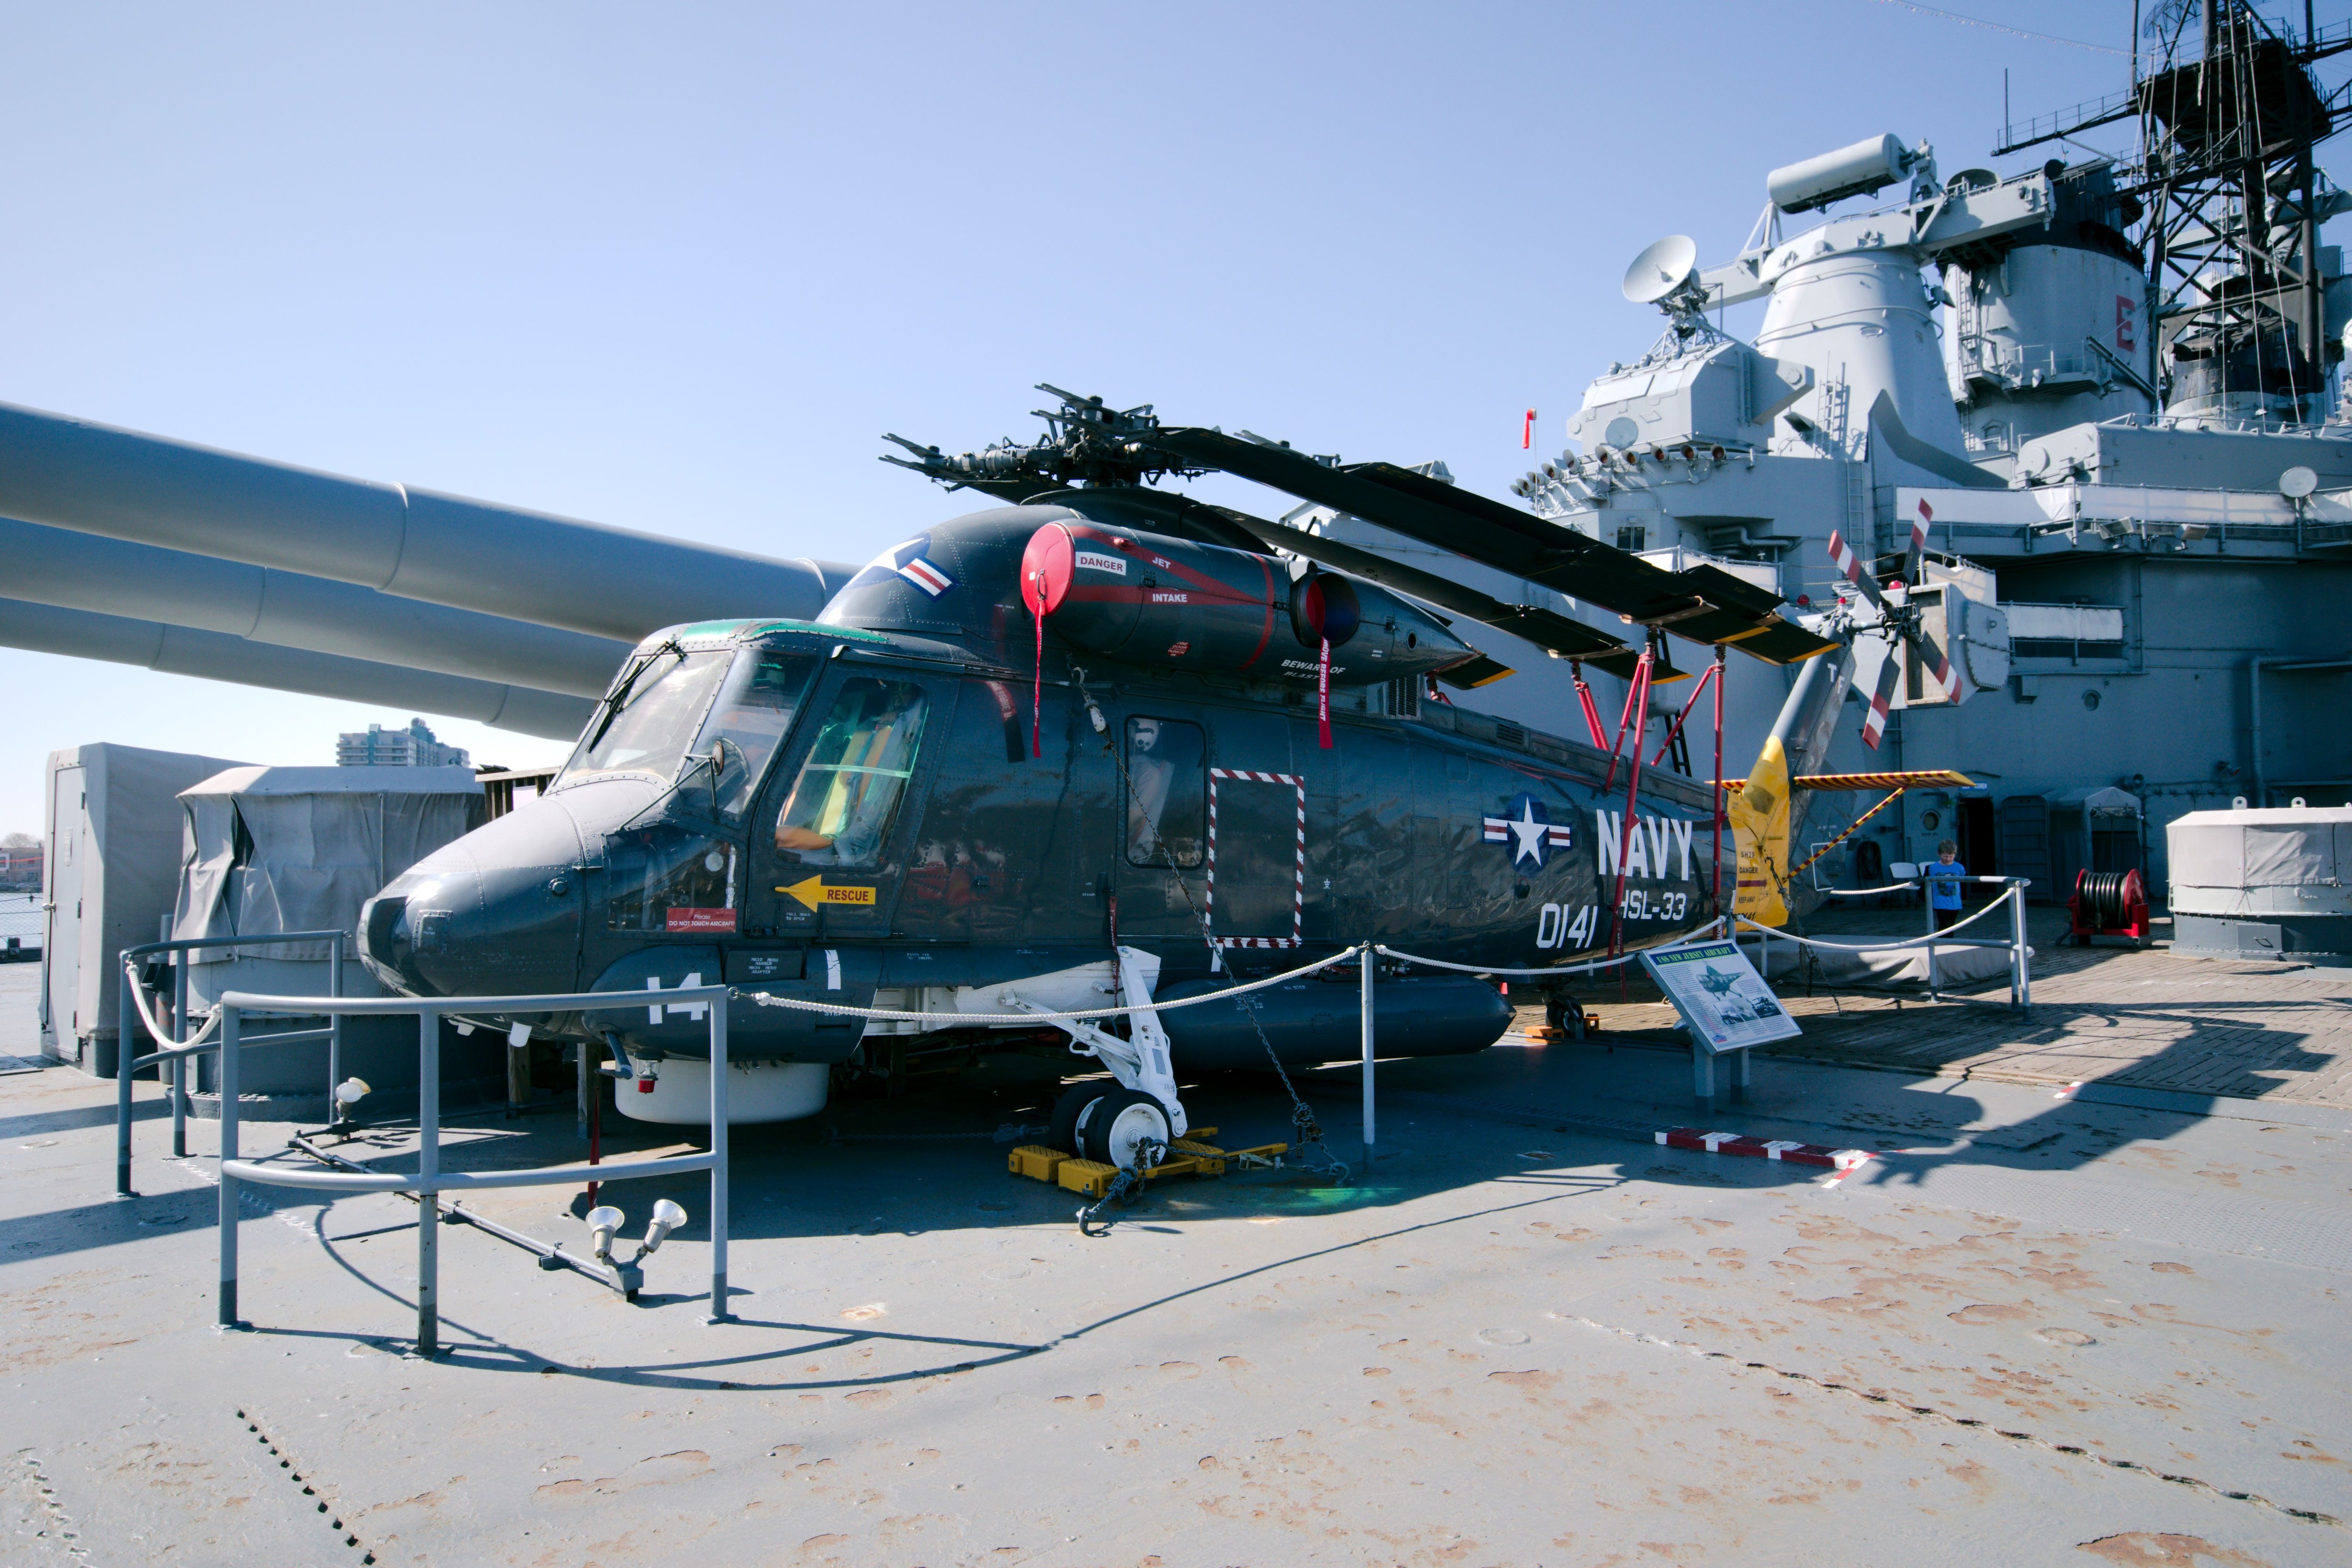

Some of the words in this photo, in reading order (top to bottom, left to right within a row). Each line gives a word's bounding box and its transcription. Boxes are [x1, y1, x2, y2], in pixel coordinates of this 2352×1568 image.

[2116, 295, 2137, 353] E
[1080, 556, 1123, 572] DANGER
[1152, 557, 1171, 569] JET
[1153, 593, 1187, 603] INTAKE
[1321, 637, 1329, 662] MOVE
[1281, 659, 1321, 671] BEWAR
[1283, 671, 1319, 680] BLAST
[1596, 809, 1692, 881] NAVY
[827, 889, 869, 901] RESCUE
[1619, 890, 1687, 921] HSL-33
[1536, 903, 1598, 949] 0141
[1656, 953, 1670, 964] USS
[1670, 952, 1682, 962] NEW
[1682, 949, 1705, 960] JERSEY
[1705, 947, 1732, 957] AIRCRAFT
[647, 973, 709, 1025] 14
